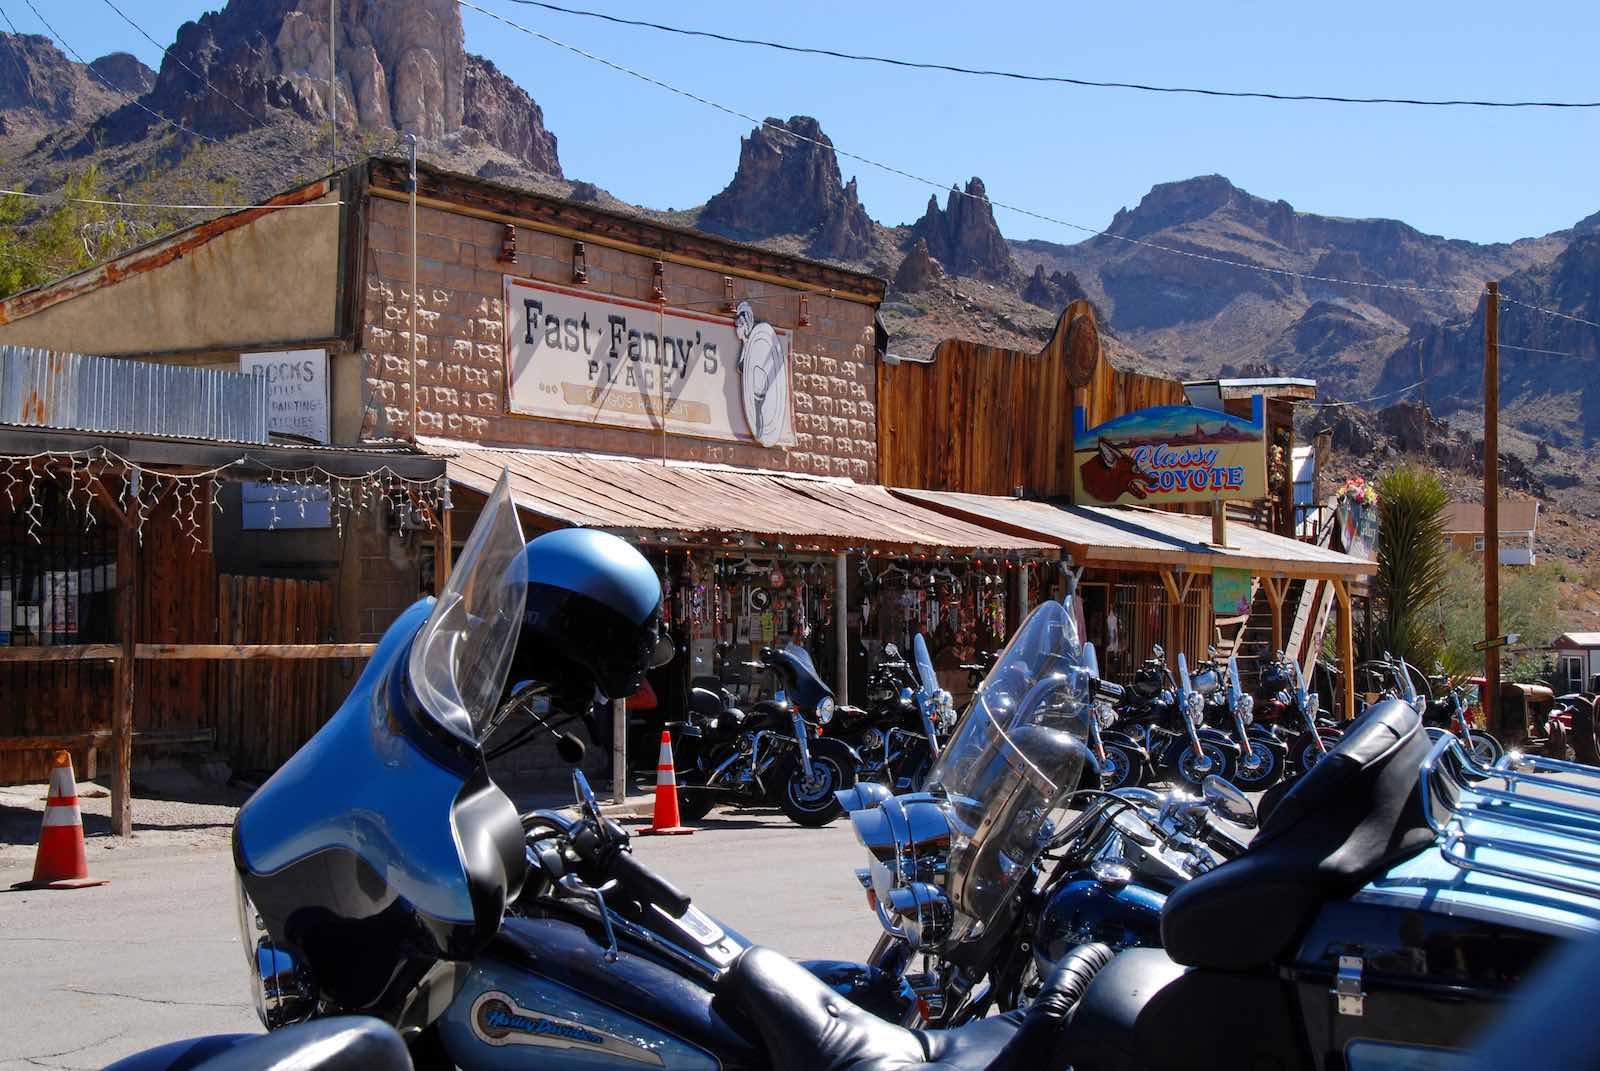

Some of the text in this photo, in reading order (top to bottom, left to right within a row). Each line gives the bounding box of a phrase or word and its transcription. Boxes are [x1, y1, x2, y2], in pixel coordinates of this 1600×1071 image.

[523, 299, 718, 379] Fast Fanny's
[588, 359, 674, 392] PLACE
[1133, 443, 1220, 468] Classy
[1147, 466, 1245, 491] COYOTE
